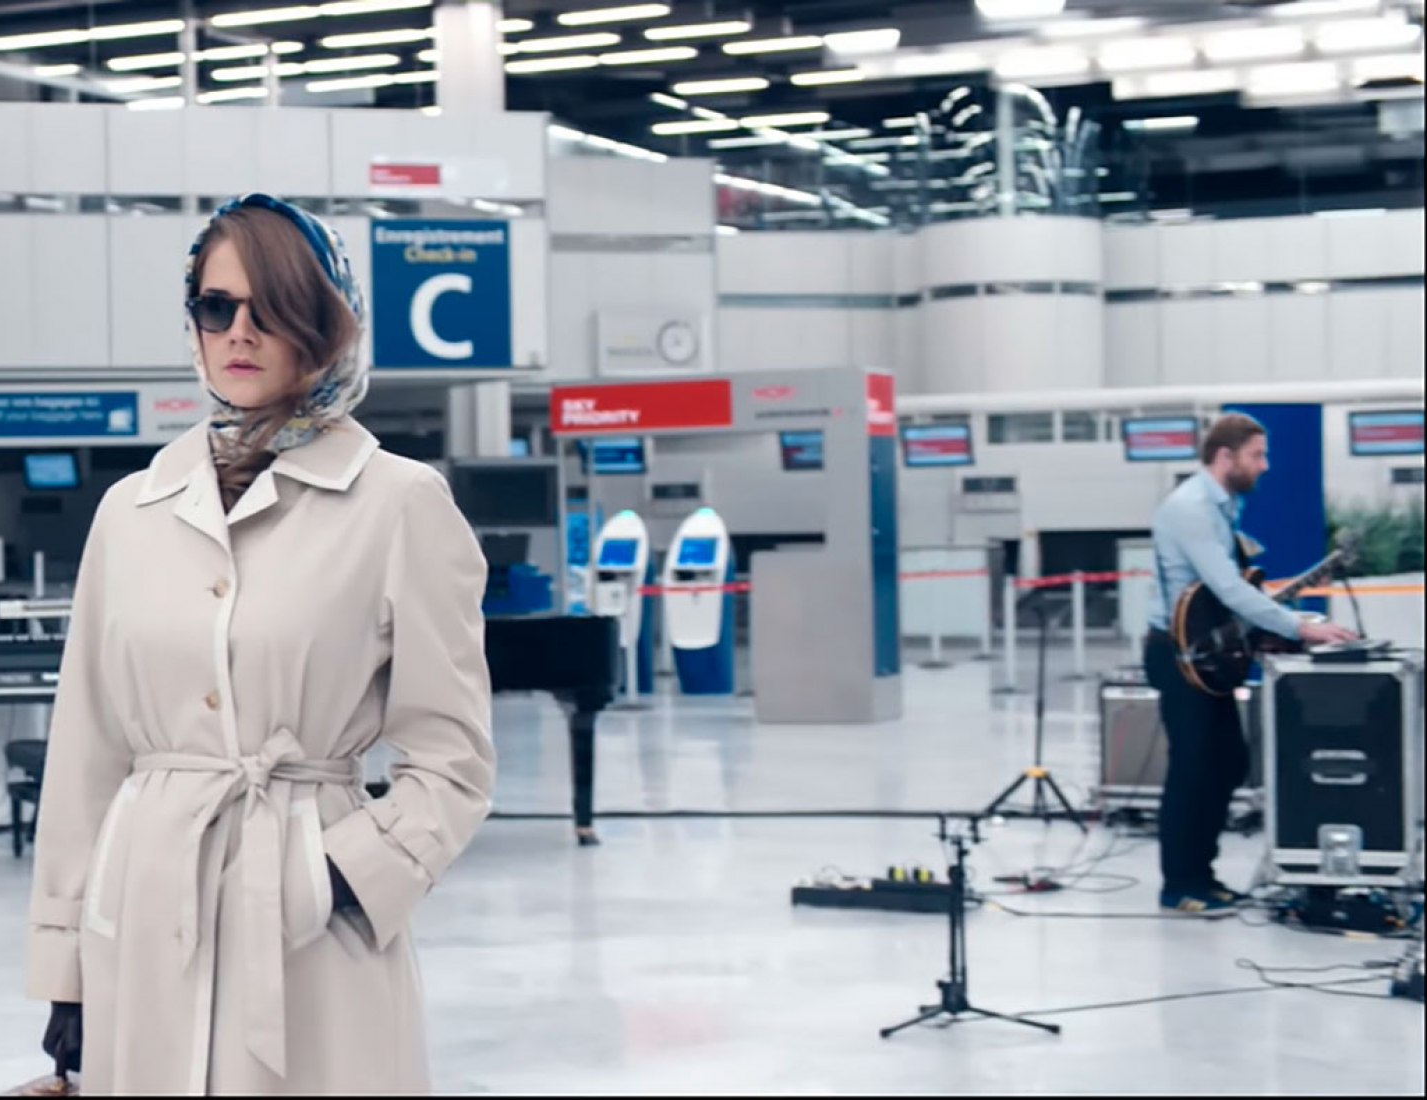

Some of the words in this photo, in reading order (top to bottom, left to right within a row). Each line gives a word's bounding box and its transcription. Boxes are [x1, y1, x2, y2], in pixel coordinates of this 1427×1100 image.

[375, 226, 504, 246] Enregistrement
[404, 246, 477, 263] Check-in
[409, 272, 474, 360] C
[562, 399, 596, 411] SKY
[562, 410, 640, 426] PRIORITY
